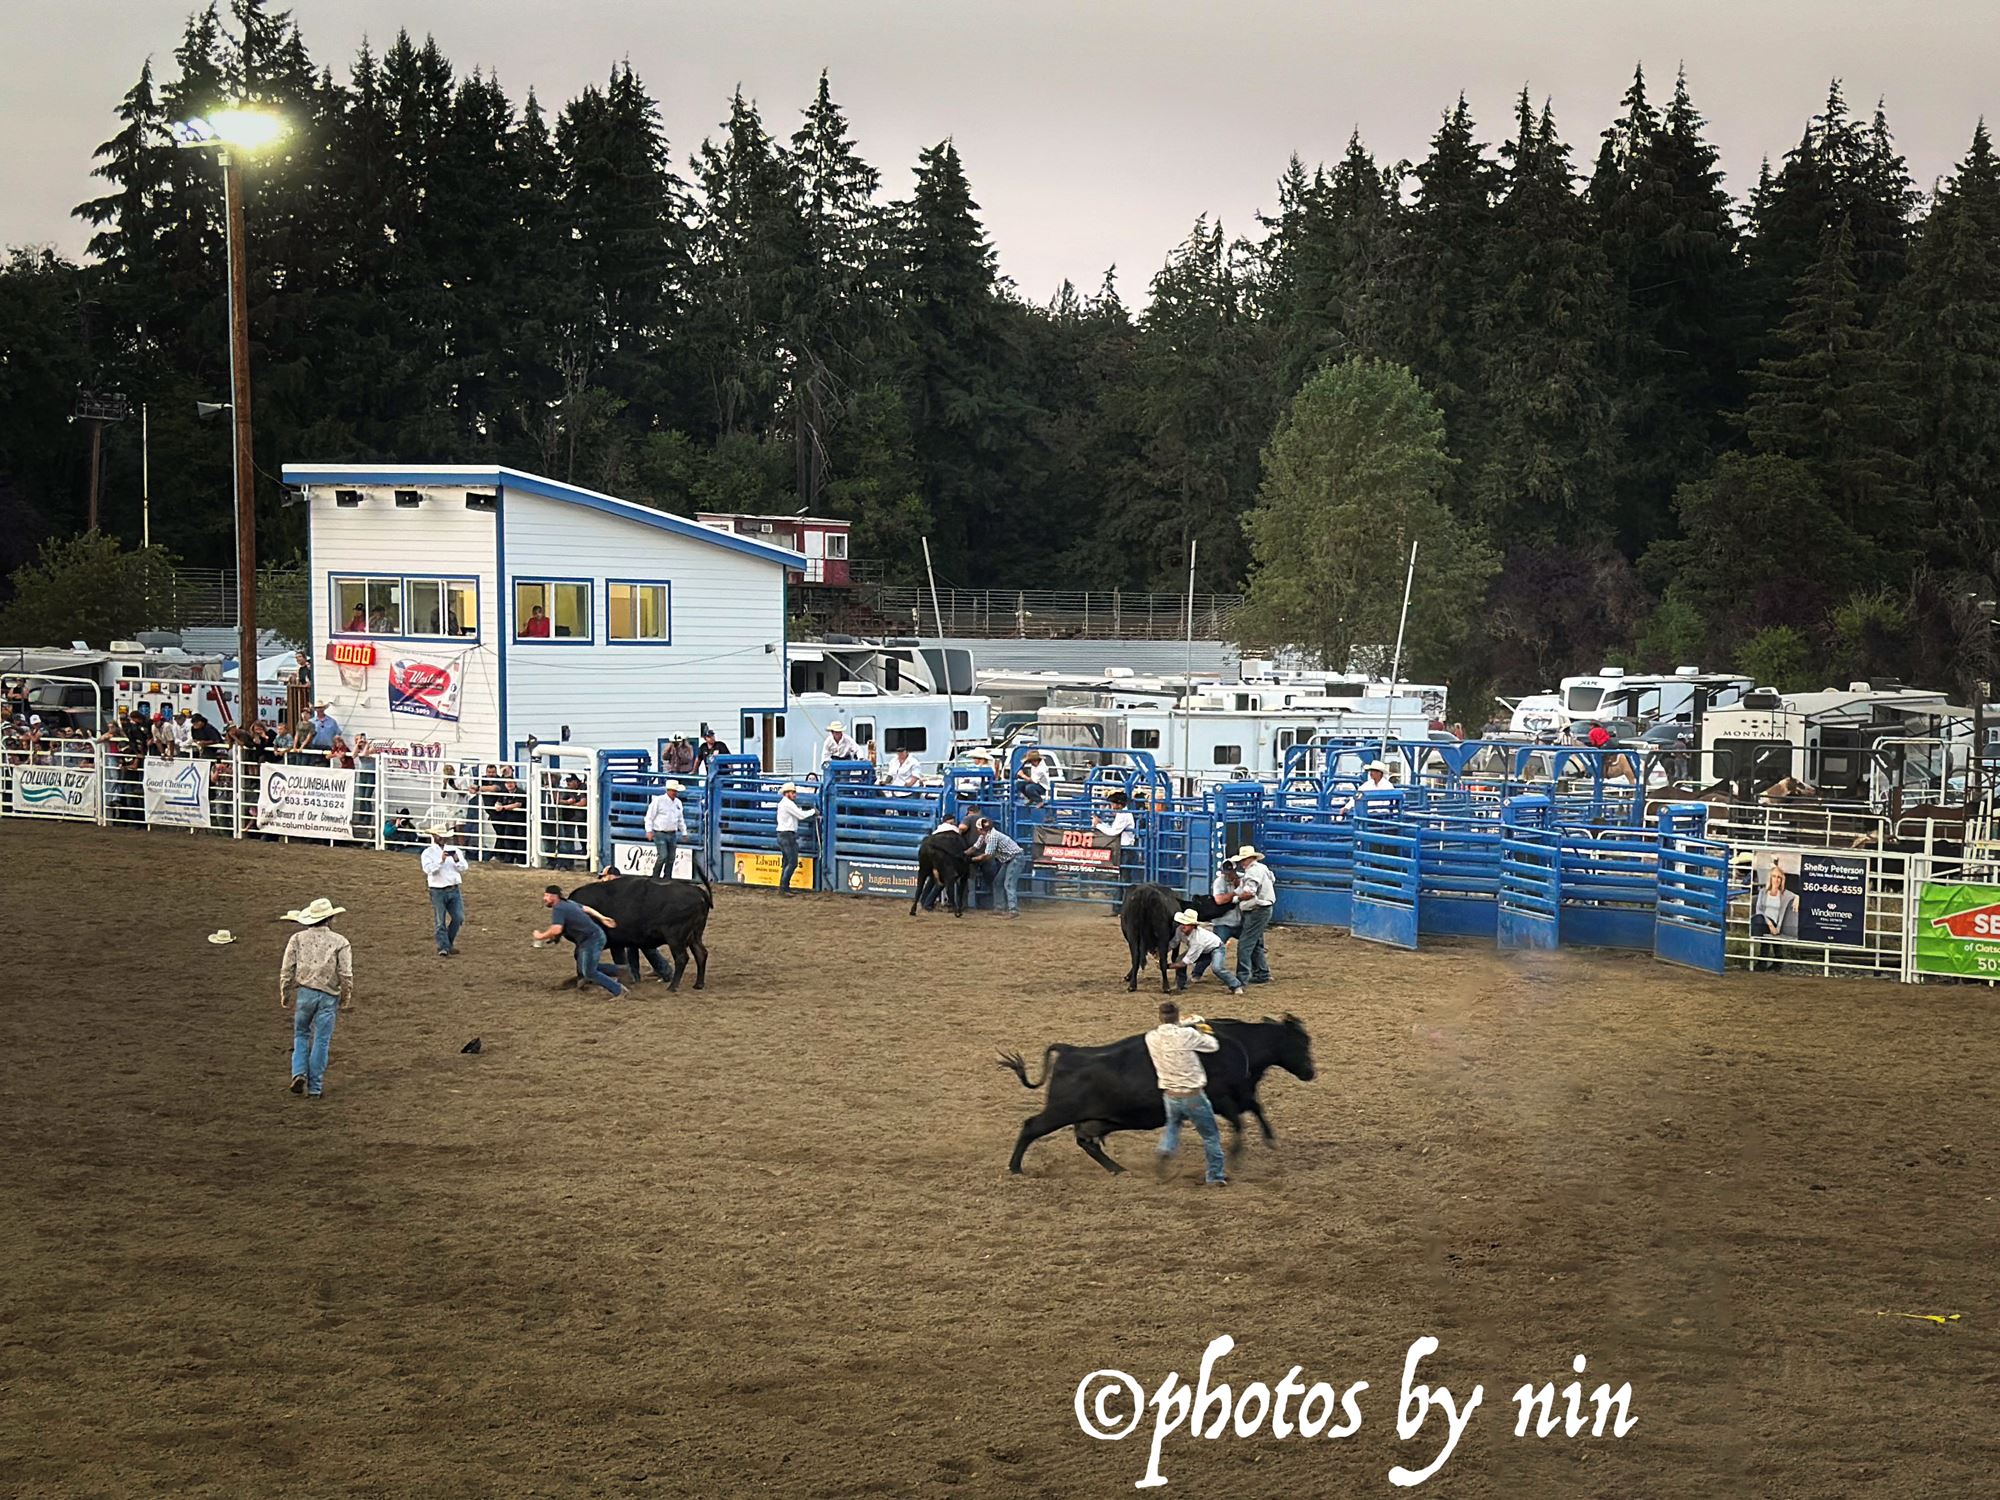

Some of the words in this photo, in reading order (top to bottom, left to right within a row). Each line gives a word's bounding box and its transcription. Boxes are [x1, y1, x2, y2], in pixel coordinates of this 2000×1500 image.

[1723, 730, 1783, 738] MONTANA
[20, 770, 62, 787] COLUMBIA
[64, 772, 89, 789] RIVER
[146, 778, 163, 788] Good
[164, 779, 192, 789] Choices
[287, 776, 331, 791] COLUMBIA
[331, 779, 346, 793] NW
[67, 790, 82, 805] HD
[284, 796, 345, 809] 503.543.3624
[307, 811, 318, 821] Our
[1061, 830, 1095, 848] RDA
[755, 855, 781, 867] Edward
[1804, 862, 1829, 873] Shelby
[1830, 864, 1864, 875] Peterson
[868, 873, 892, 886] hagan
[892, 874, 918, 887] hamilt
[1803, 882, 1863, 895] 360-846-3559
[1811, 908, 1853, 920] Windermere
[1974, 913, 2000, 935] SE
[1964, 943, 1974, 952] of
